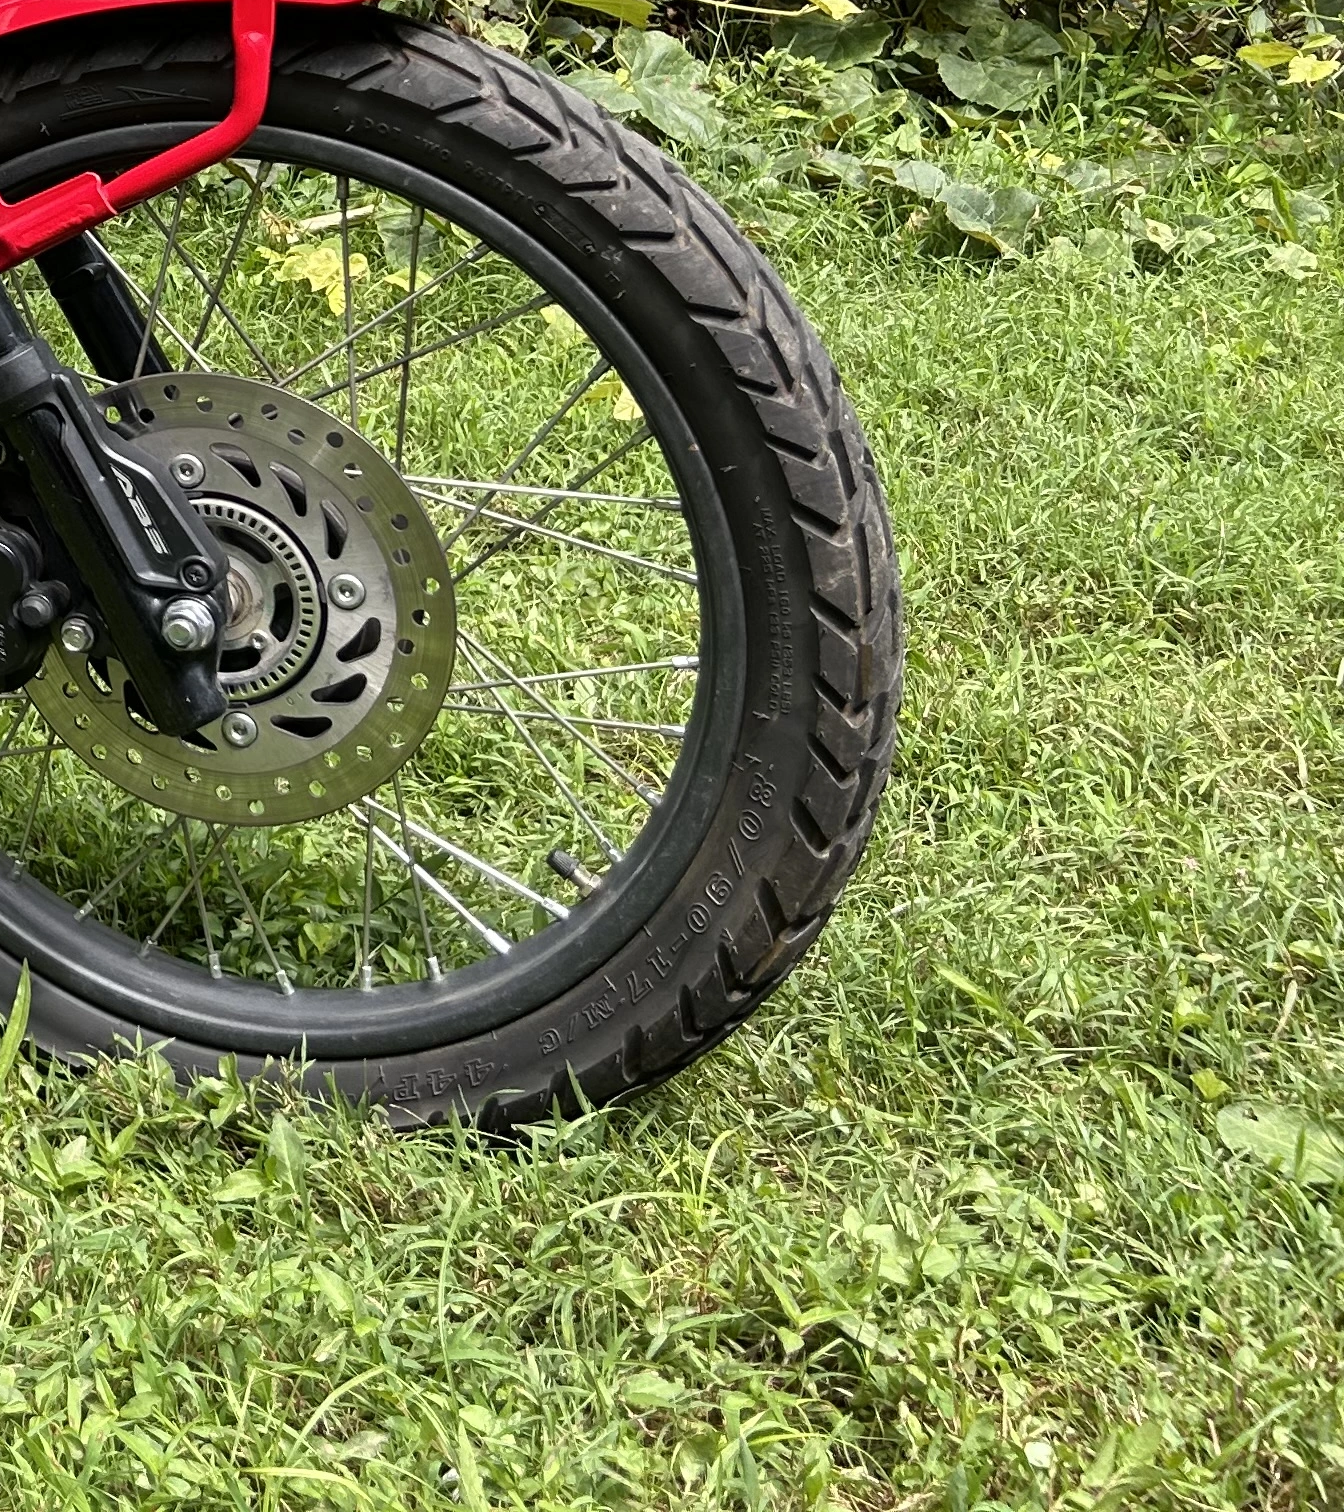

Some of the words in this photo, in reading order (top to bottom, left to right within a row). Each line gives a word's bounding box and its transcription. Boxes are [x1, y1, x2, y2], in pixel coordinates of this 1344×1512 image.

[109, 462, 172, 555] ABS
[626, 772, 777, 1005] 80/90-17
[538, 993, 616, 1055] M/C
[392, 1057, 495, 1102] 44P
